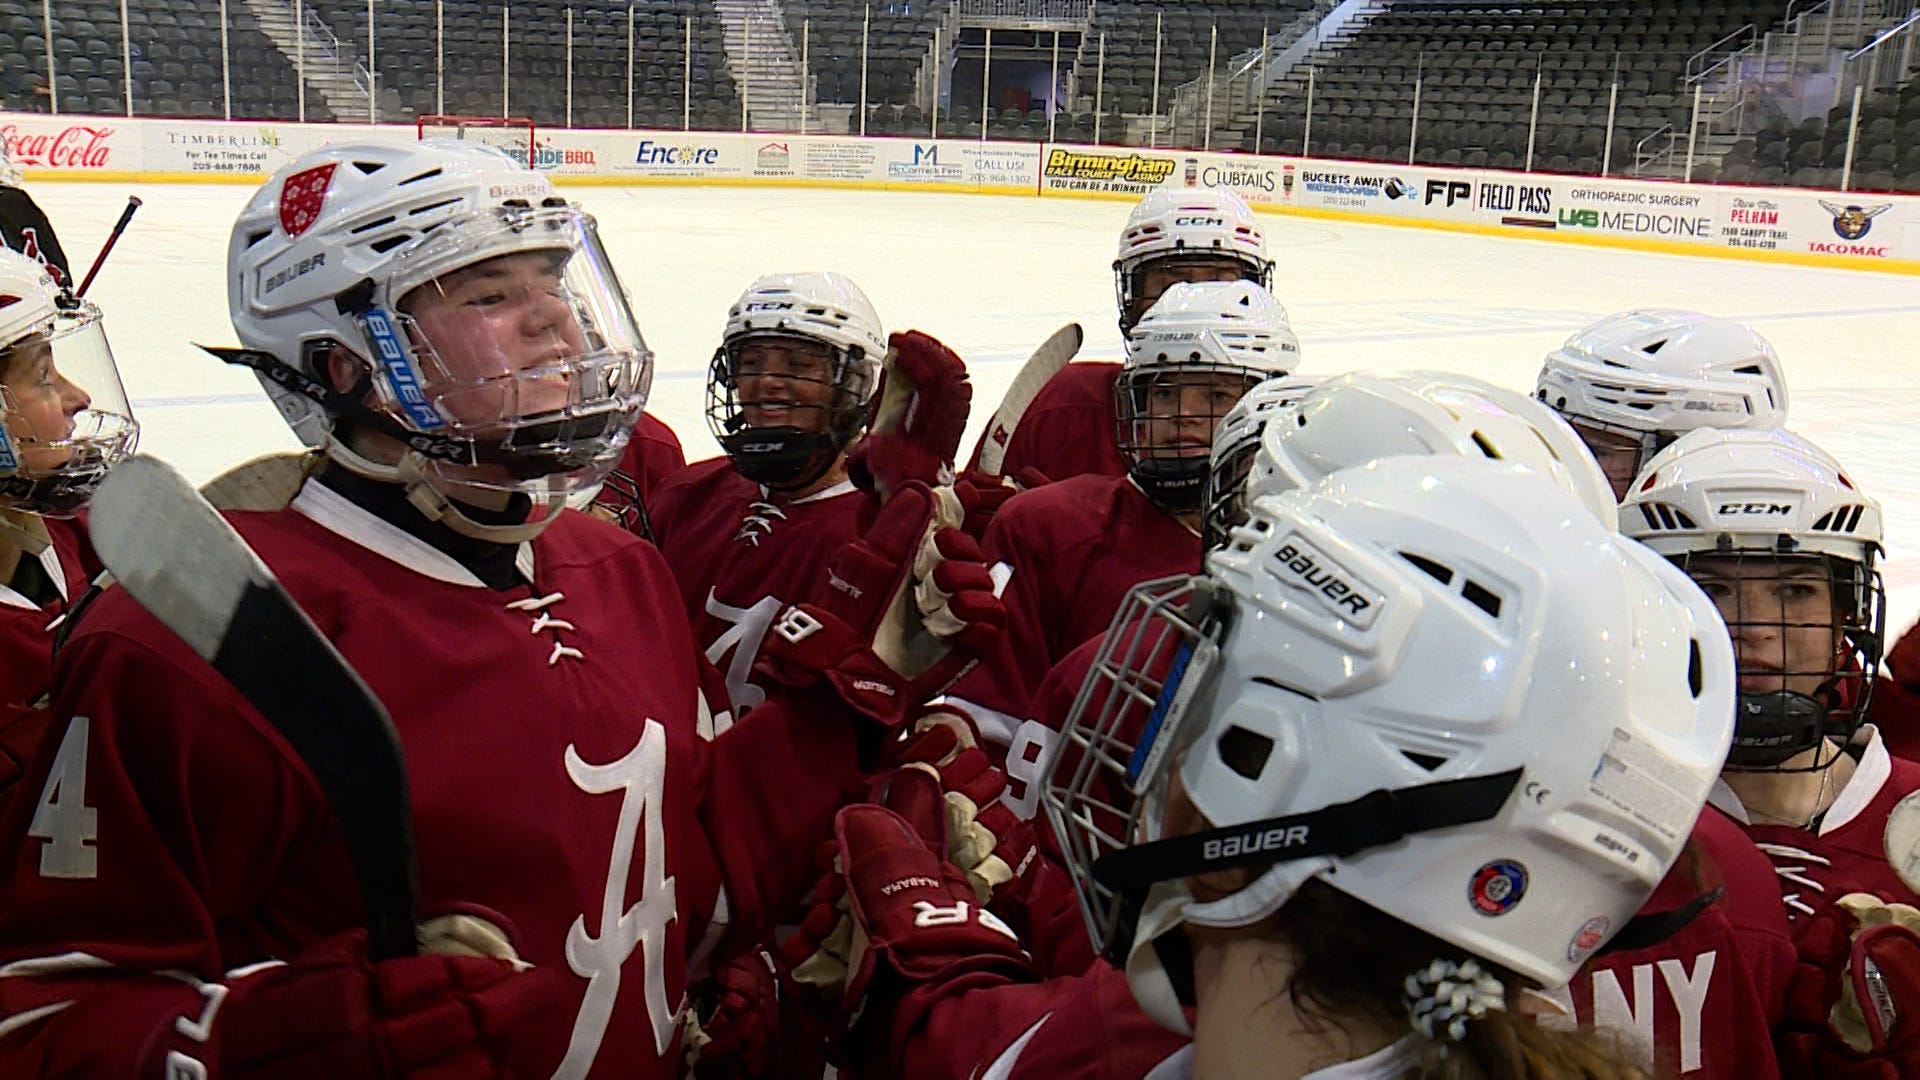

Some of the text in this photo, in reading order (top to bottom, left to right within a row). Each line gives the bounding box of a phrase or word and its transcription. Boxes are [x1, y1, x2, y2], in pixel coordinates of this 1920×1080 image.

[167, 132, 282, 146] TIMBERLINE
[204, 152, 218, 160] Tee
[221, 152, 247, 160] Times
[565, 151, 596, 166] BBQ
[636, 141, 719, 166] Encore
[974, 160, 1003, 170] CALL
[1049, 150, 1175, 175] Birmingham
[1050, 180, 1067, 188] YOU
[1070, 181, 1087, 190] CAN
[1090, 182, 1101, 191] BE
[1103, 183, 1109, 191] A
[1111, 183, 1146, 193] WINNER
[1203, 167, 1275, 192] CLUBTAILS
[1302, 171, 1384, 188] BUCKETS AWAY
[1424, 179, 1471, 208] FP
[1480, 183, 1552, 213] FIELD PASS
[1571, 189, 1701, 208] ORTHOPAEDIC SURGERY
[1175, 217, 1223, 226] CCM
[1602, 211, 1712, 238] MEDICINE
[1731, 209, 1778, 224] PELHAM
[1809, 242, 1888, 258] TACO MAC
[266, 253, 326, 293] BAUER
[368, 314, 439, 425] BAUER
[1718, 503, 1792, 515] CCM
[1273, 541, 1370, 617] BAUER
[28, 716, 97, 878] 4
[1203, 825, 1309, 860] BAUER
[549, 717, 679, 1080] A
